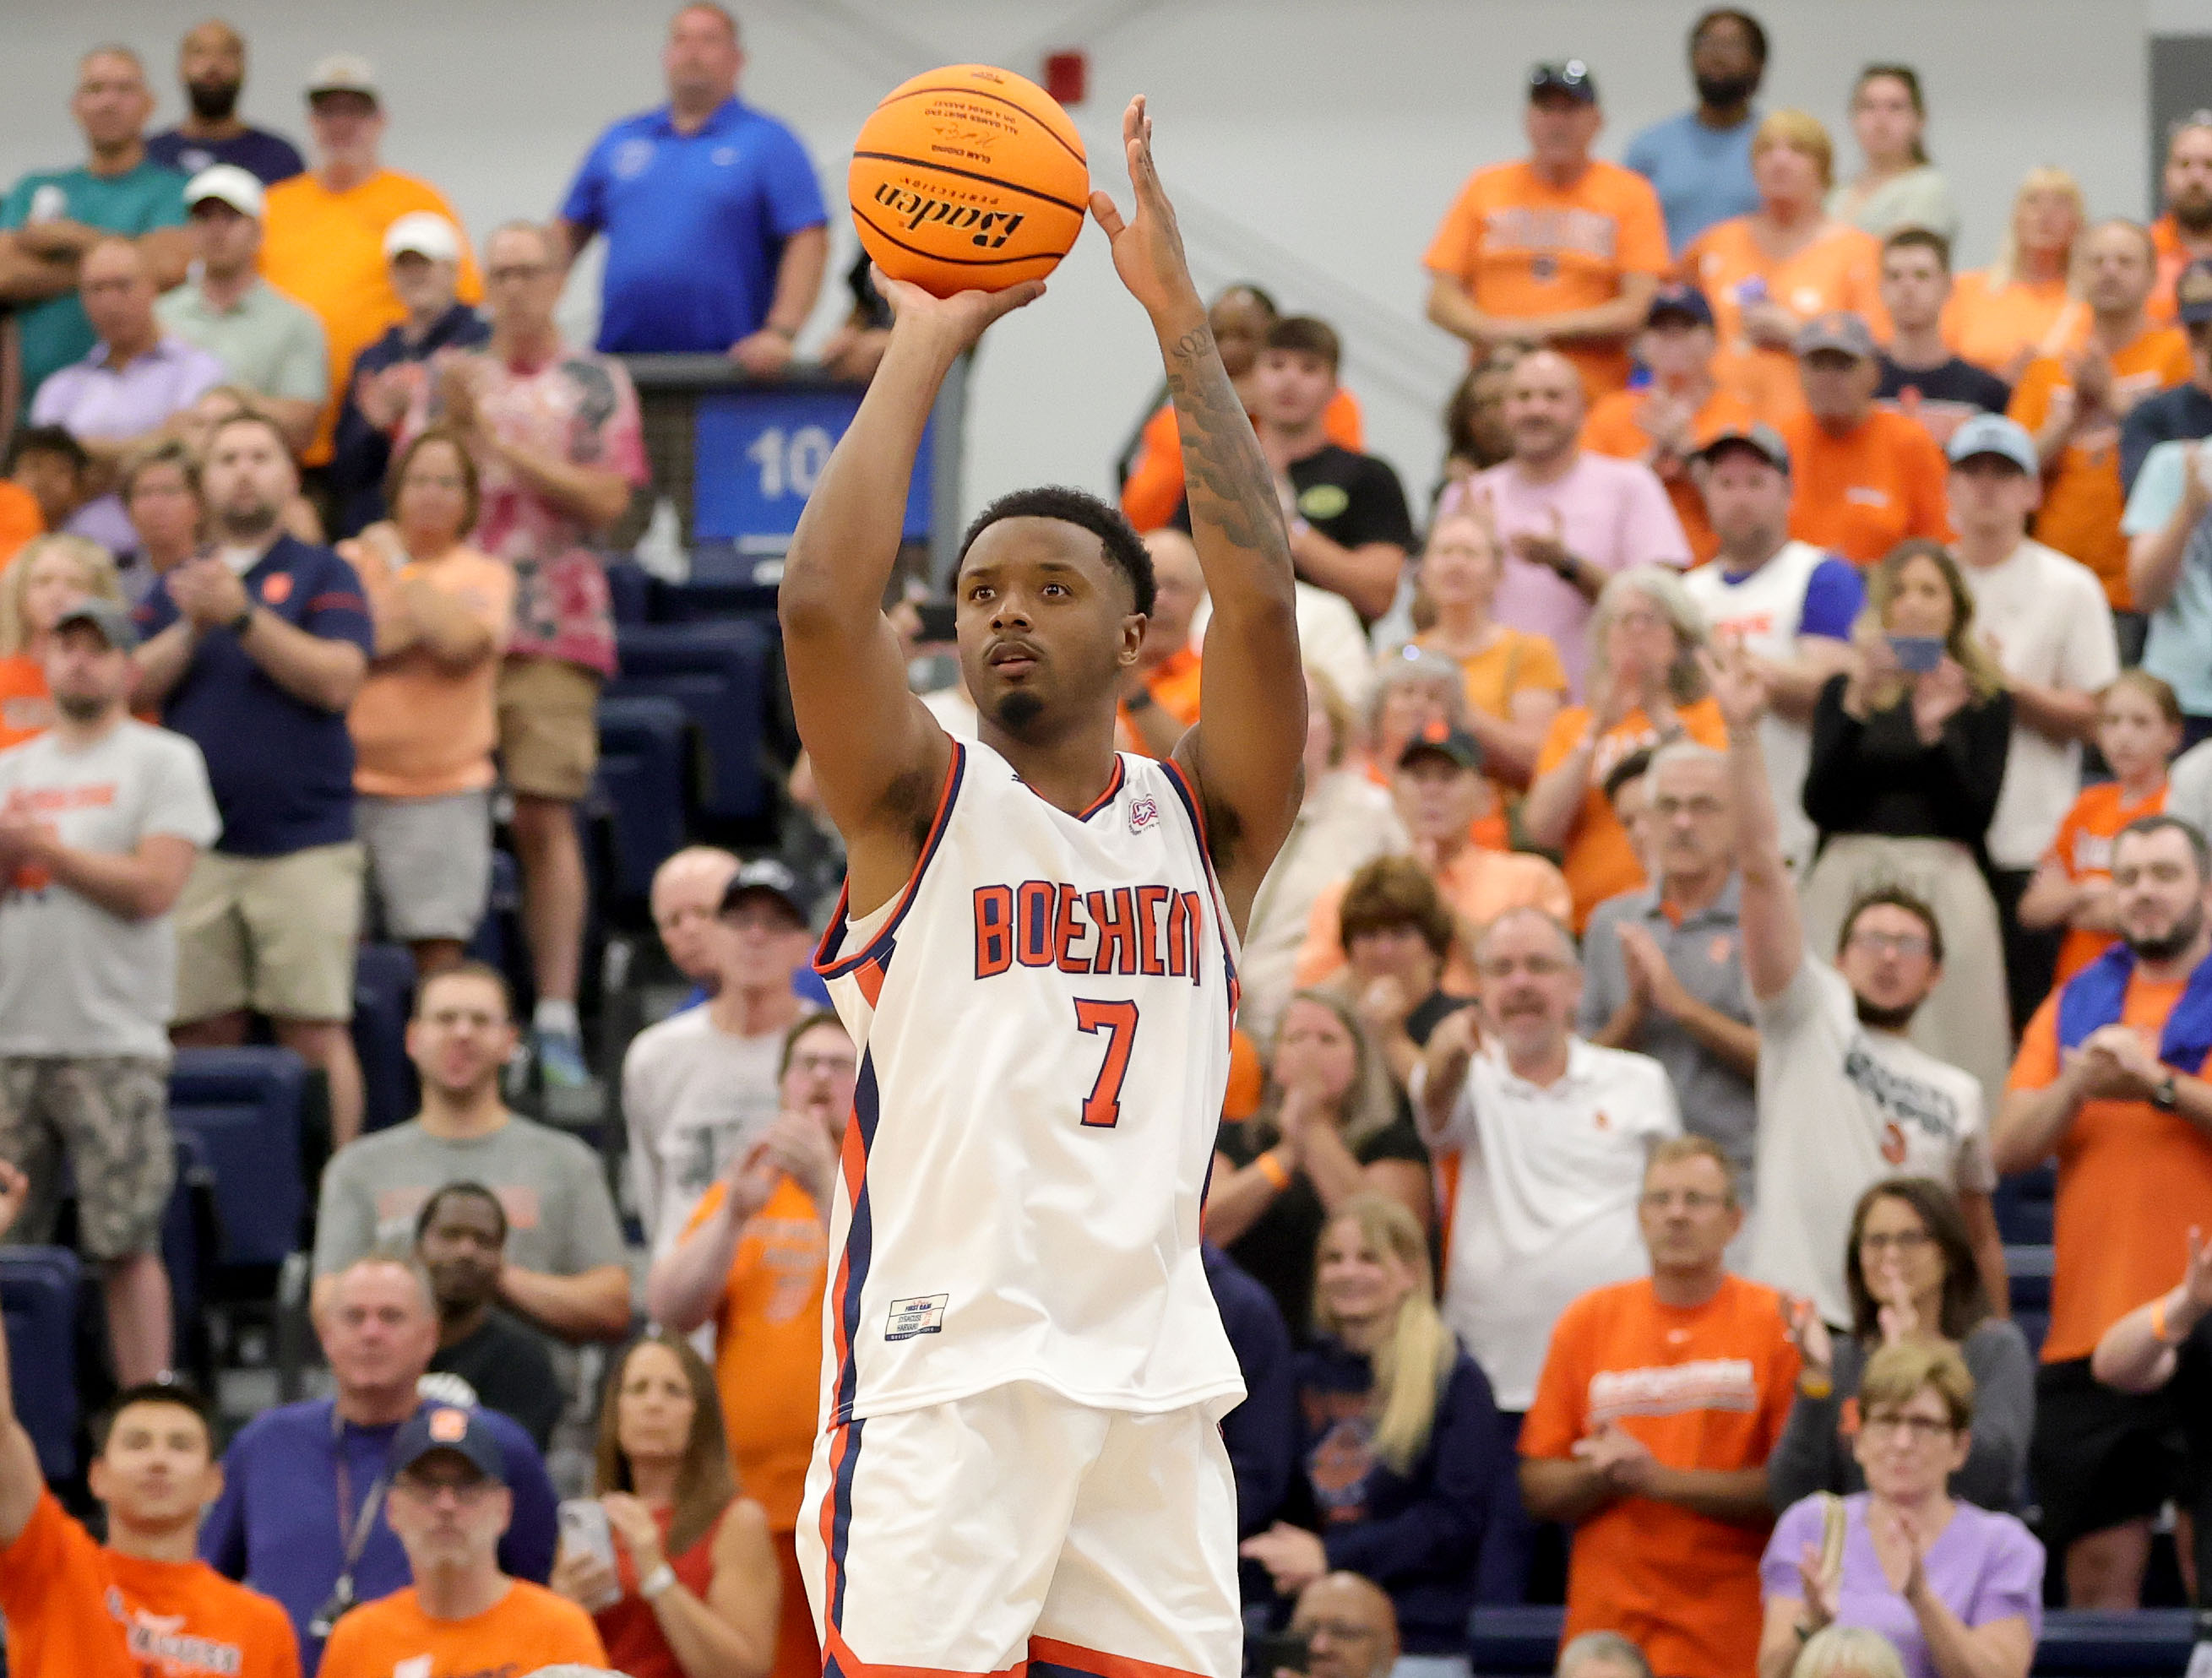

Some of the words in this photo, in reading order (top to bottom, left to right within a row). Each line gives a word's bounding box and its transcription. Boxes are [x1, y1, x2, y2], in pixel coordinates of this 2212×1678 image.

[873, 182, 1024, 249] Baden
[902, 177, 999, 205] PERFECTION
[747, 425, 834, 499] 10
[1073, 996, 1139, 1128] 7
